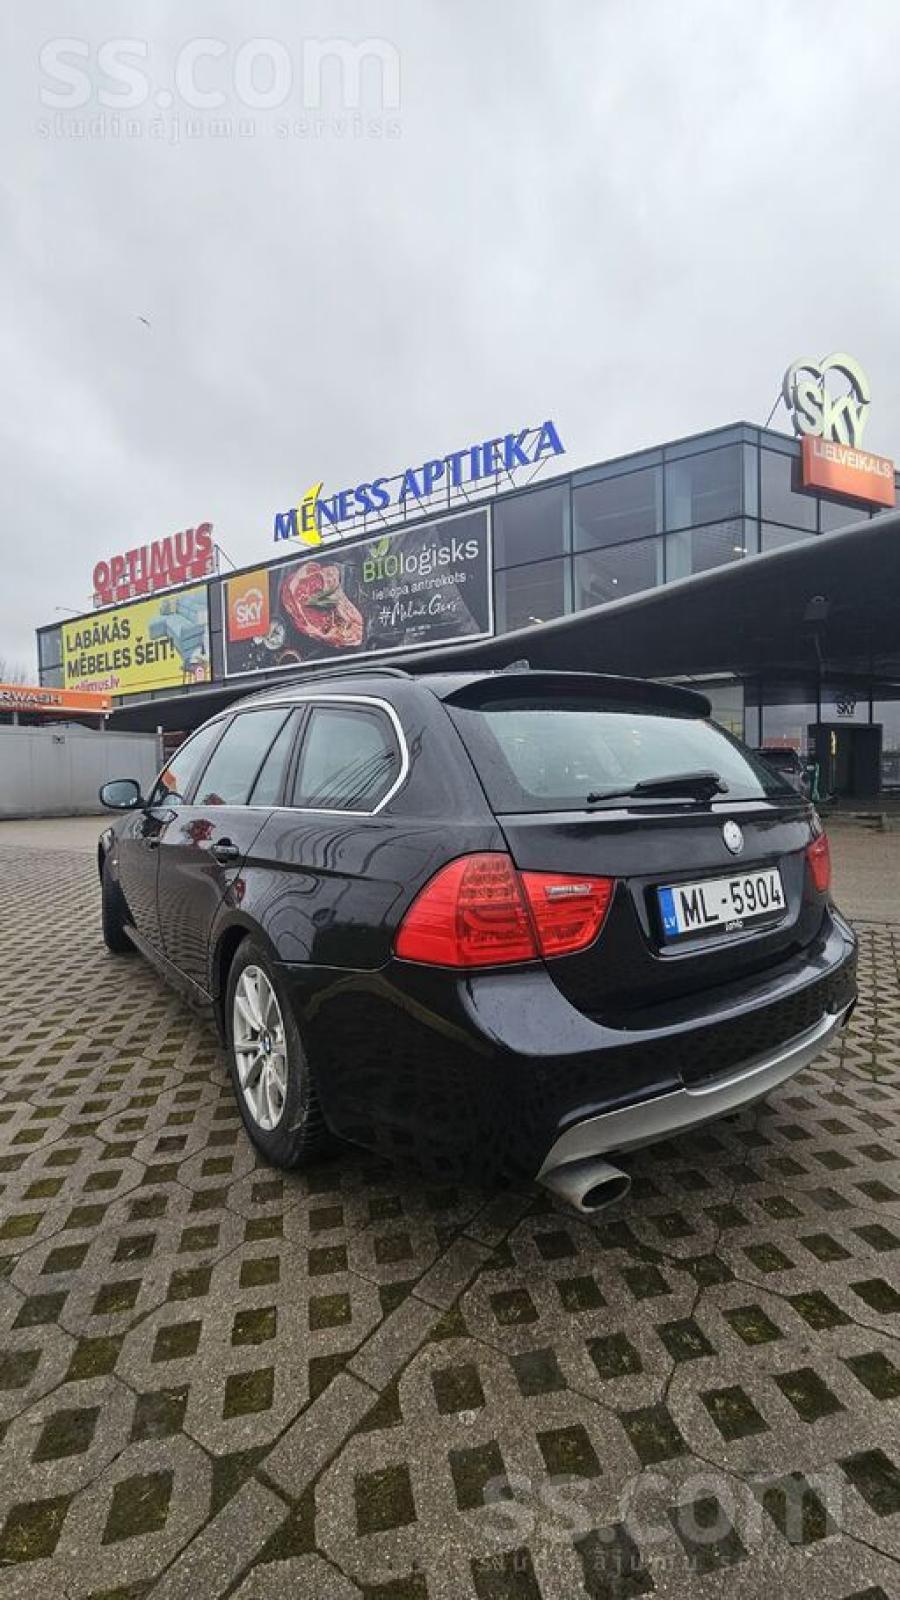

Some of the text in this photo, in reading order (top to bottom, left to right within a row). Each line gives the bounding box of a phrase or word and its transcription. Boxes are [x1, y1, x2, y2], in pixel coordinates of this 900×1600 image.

[796, 380, 869, 447] SKY
[813, 440, 894, 479] LIELVEIKALS
[273, 420, 566, 542] MĒNESS APTIEKA
[92, 522, 213, 592] OPTIMUS
[66, 617, 131, 652] LABĀKĀS
[236, 602, 262, 625] SKY
[67, 636, 175, 678] MĒBELES ŠEIT!
